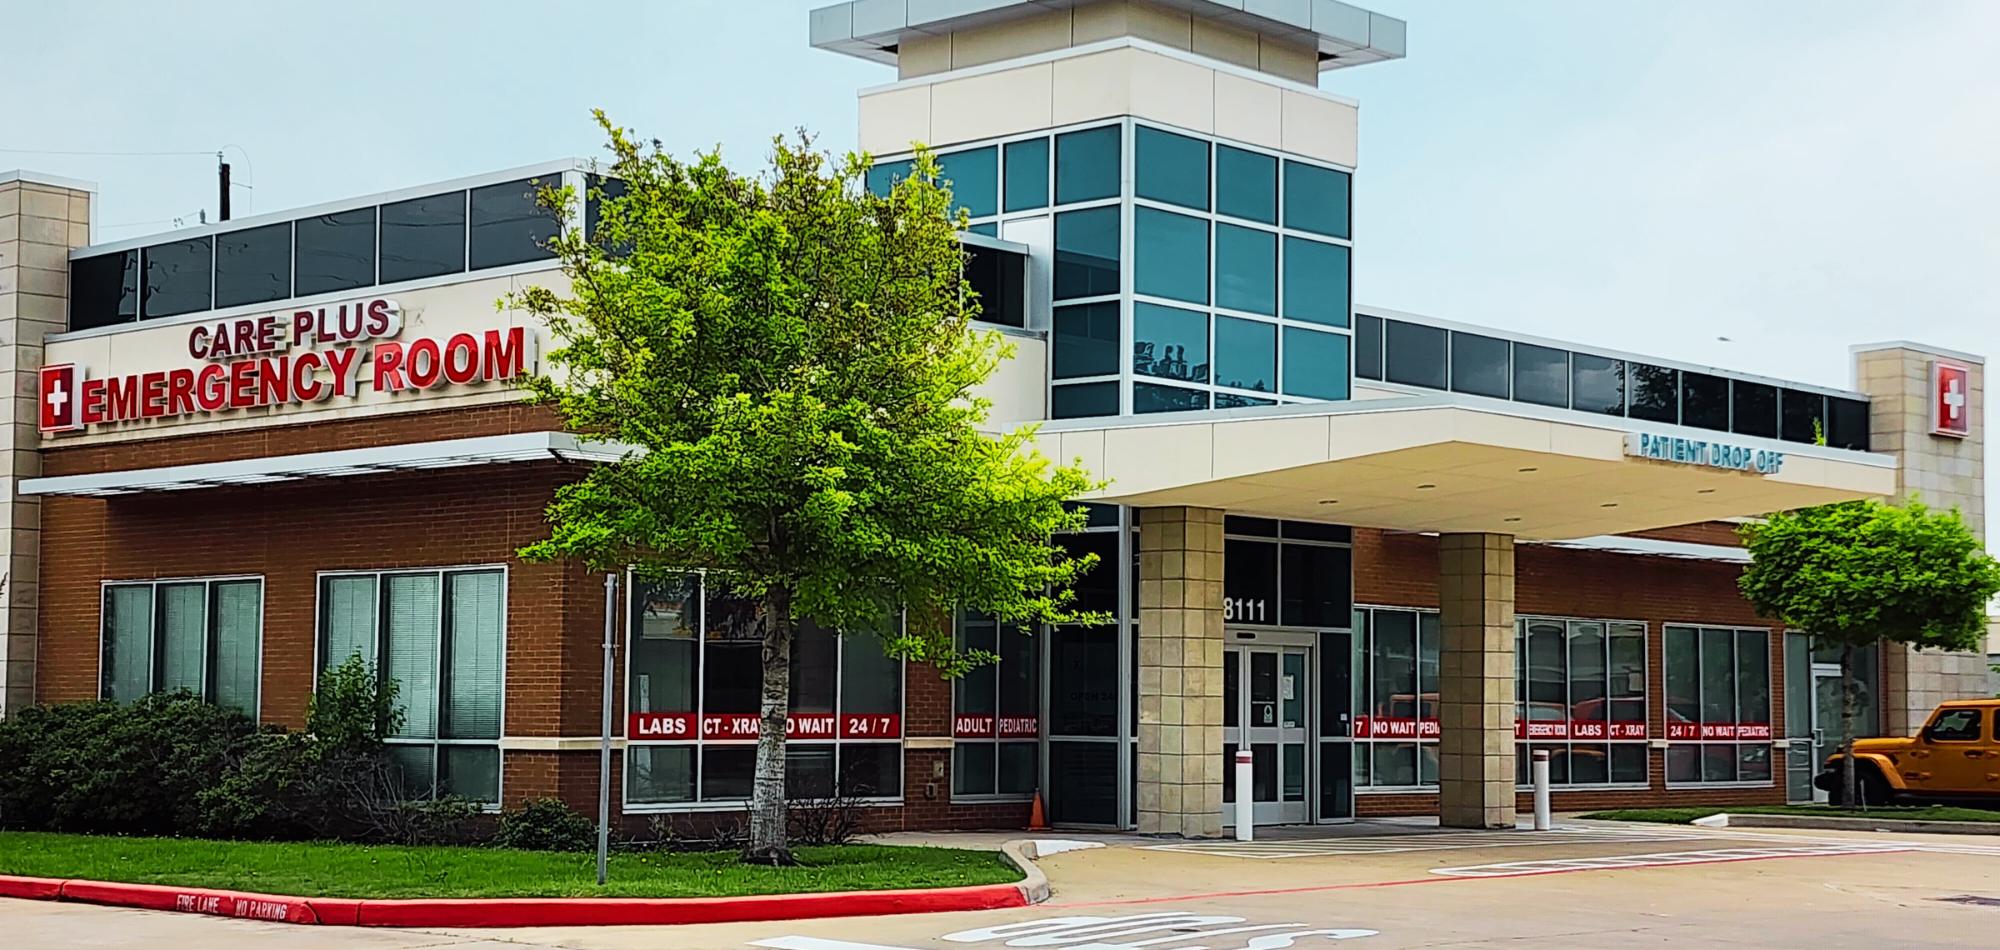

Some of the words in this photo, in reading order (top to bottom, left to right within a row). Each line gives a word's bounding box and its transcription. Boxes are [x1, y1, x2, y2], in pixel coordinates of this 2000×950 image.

[188, 314, 277, 360] CARE
[293, 299, 391, 347] PLUS
[81, 345, 363, 425] EMERGENCY
[373, 327, 524, 392] ROOM
[1640, 433, 1707, 462] PATIENT
[1711, 443, 1751, 469] DROP
[1756, 450, 1784, 473] OFF
[1223, 597, 1265, 622] 8111
[639, 717, 687, 735] LABS
[703, 717, 722, 735] CT
[799, 717, 835, 735] WAIT
[956, 718, 992, 733] ADULT
[999, 718, 1037, 733] PEDIATRIC
[1373, 721, 1388, 735] NO
[1390, 721, 1416, 735] WAIT
[1574, 724, 1602, 736] LABS
[1609, 724, 1619, 736] CT
[1625, 724, 1645, 736] XRAY
[1702, 725, 1713, 737] NO
[1715, 725, 1735, 737] WAIT
[1737, 725, 1769, 737] PEDIATRIC
[176, 894, 196, 912] FIRE
[198, 895, 220, 914] LANE
[235, 899, 248, 917] NO
[250, 901, 288, 920] PARKING
